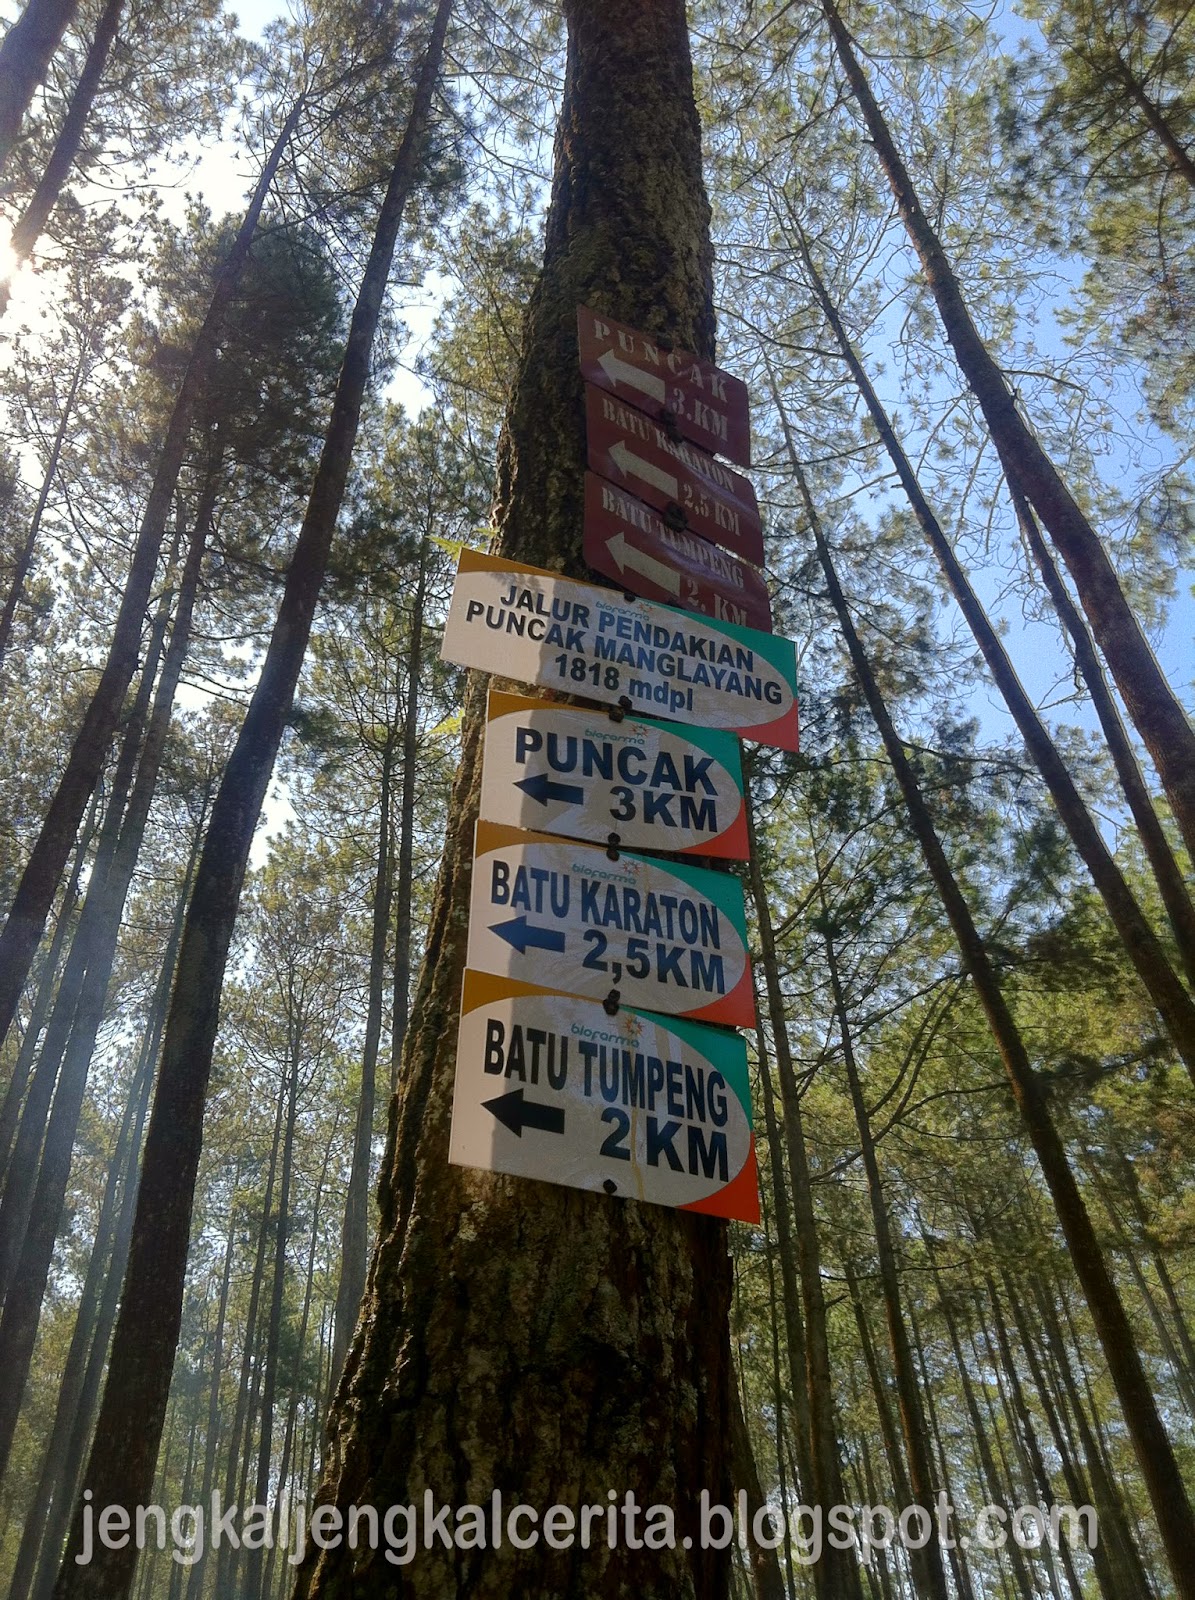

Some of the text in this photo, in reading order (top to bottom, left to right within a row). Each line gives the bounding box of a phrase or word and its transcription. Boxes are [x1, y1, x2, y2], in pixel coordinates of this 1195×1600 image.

[594, 319, 728, 403] PUNCAK
[602, 398, 651, 441] BATU
[602, 487, 652, 534] BATU
[465, 600, 783, 705] PUNCAK MANGLAYANG
[500, 586, 754, 672] JALUR PENDAKIAN
[555, 653, 694, 713] 1818 mdpl
[515, 726, 719, 796] PUNCAK
[609, 786, 718, 833] 3KM
[491, 860, 721, 950] BATU KARATON
[571, 1022, 640, 1049] biofarma
[484, 1018, 729, 1128] BATU TUMPENG
